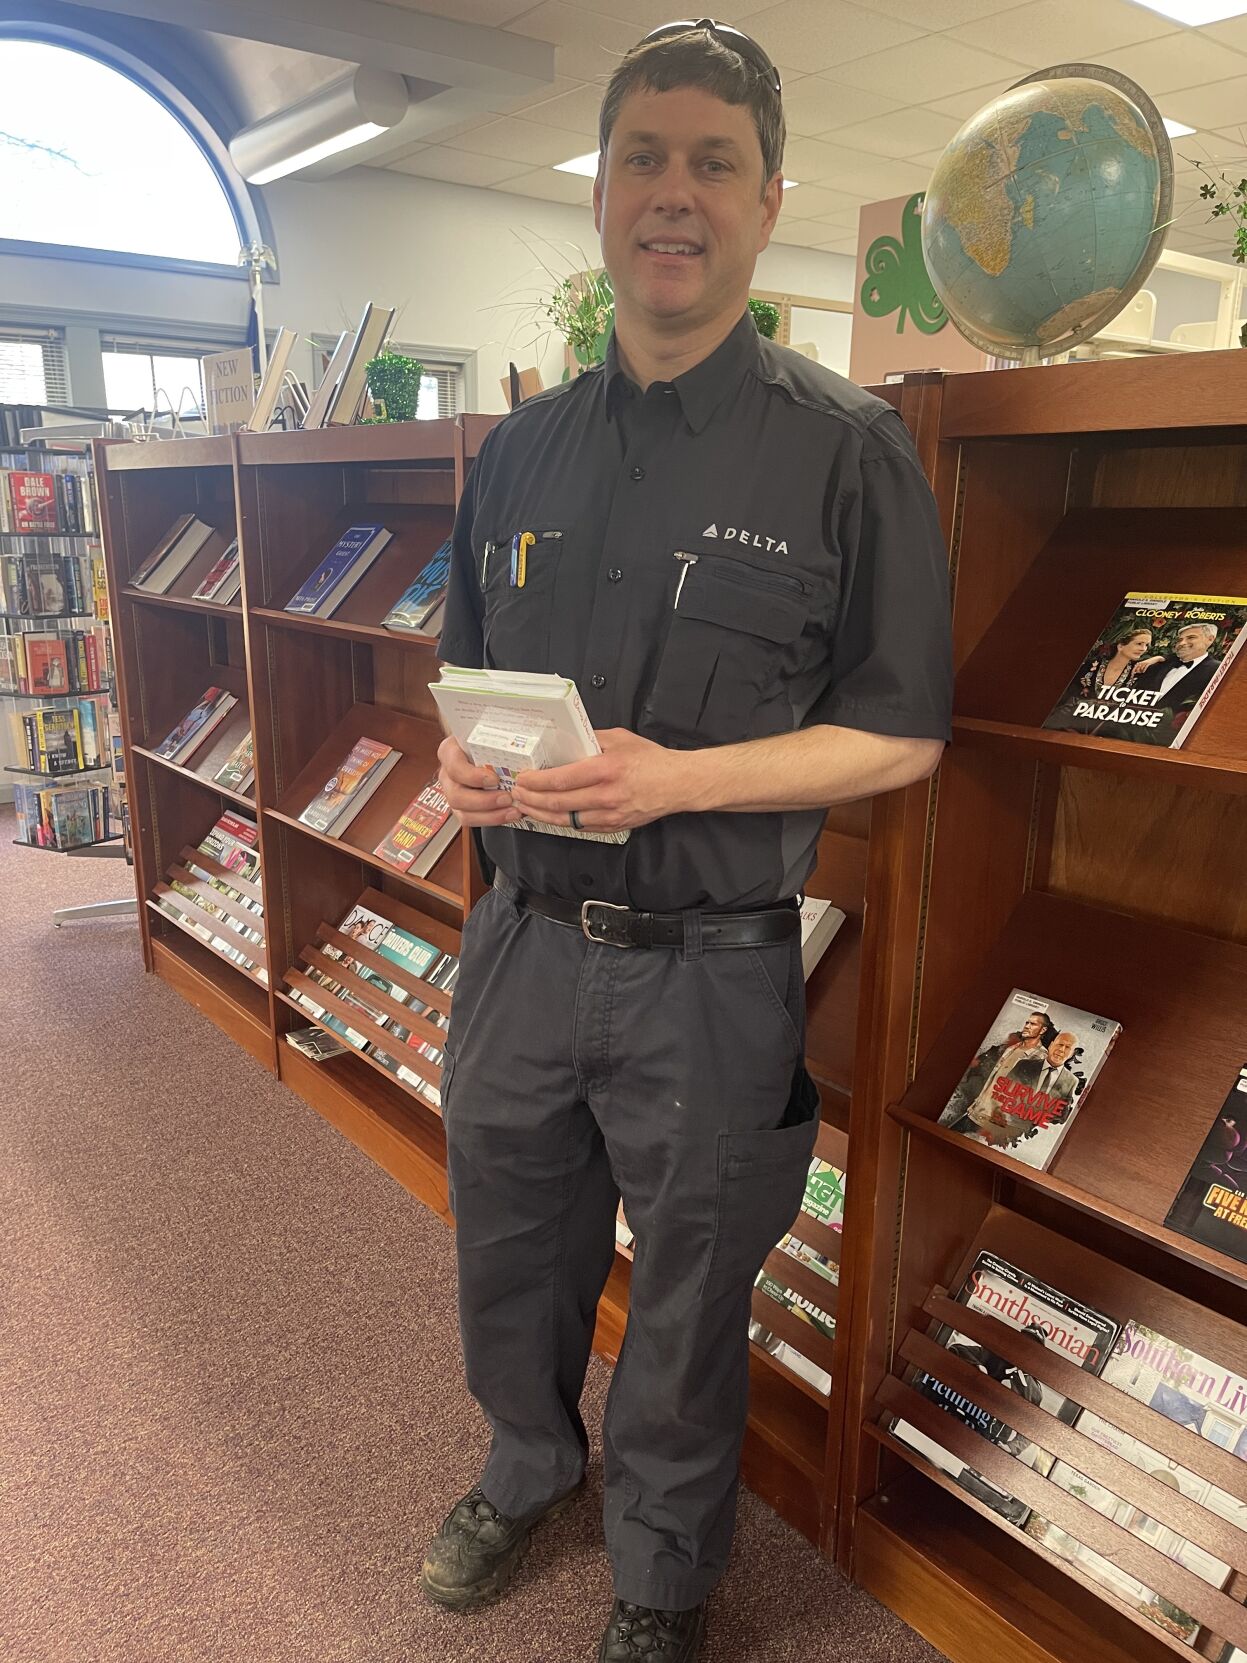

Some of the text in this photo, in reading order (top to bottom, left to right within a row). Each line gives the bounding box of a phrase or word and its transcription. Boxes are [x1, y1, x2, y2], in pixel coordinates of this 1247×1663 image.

[216, 359, 239, 377] NEW
[210, 385, 248, 405] FICTION
[20, 486, 50, 497] BROWN
[24, 477, 44, 487] DALE
[724, 527, 788, 555] DELTA
[1136, 609, 1227, 621] CLOONEY ROBERTS
[1097, 685, 1162, 706] TICKET
[1073, 702, 1163, 728] PARADISE
[393, 828, 417, 848] HAND
[408, 945, 432, 967] CLUB
[1091, 1023, 1107, 1033] WILLIS
[993, 1076, 1068, 1116] SURVIVE
[1001, 1098, 1053, 1130] GAME
[803, 1197, 830, 1216] agazine
[1206, 1186, 1236, 1209] FIVE
[1213, 1207, 1229, 1221] AT
[965, 1270, 1100, 1366] Smithsonian
[1114, 1326, 1215, 1398] Southern
[922, 1373, 991, 1429] Picturing
